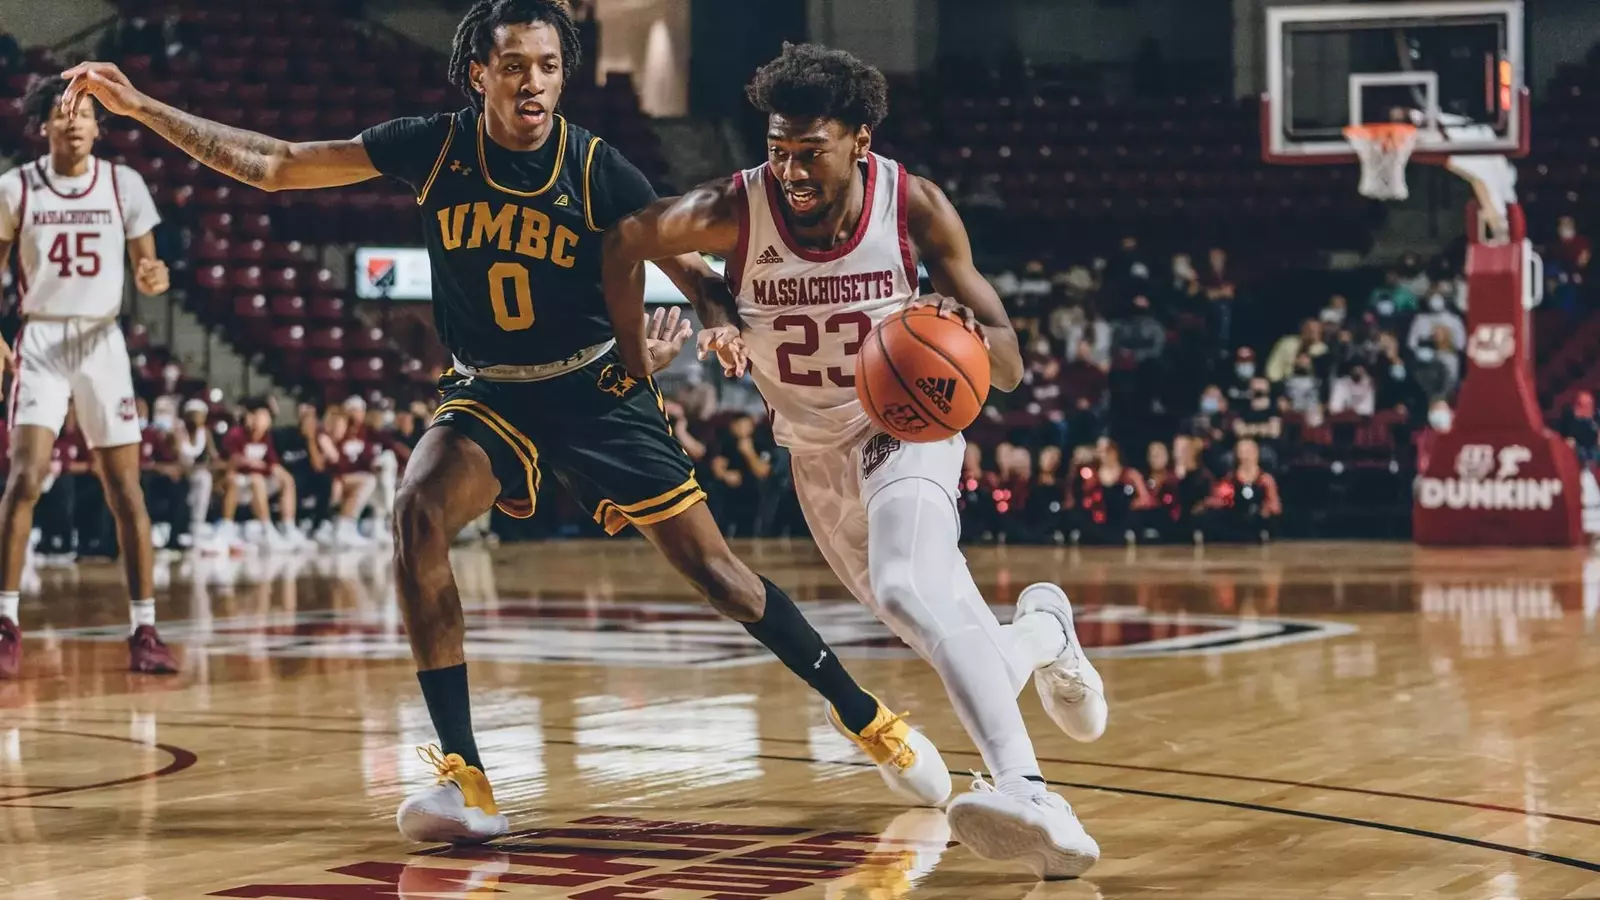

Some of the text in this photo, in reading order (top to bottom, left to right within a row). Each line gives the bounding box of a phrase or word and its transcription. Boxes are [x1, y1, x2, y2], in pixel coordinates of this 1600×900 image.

[32, 209, 112, 225] MASSACHUSETTS
[437, 201, 580, 269] UMBC
[48, 232, 101, 277] 45
[756, 256, 785, 265] adidas
[487, 262, 535, 331] 0
[752, 270, 894, 306] MASSACHUSETTS
[773, 311, 872, 387] 23
[915, 378, 952, 415] adidas
